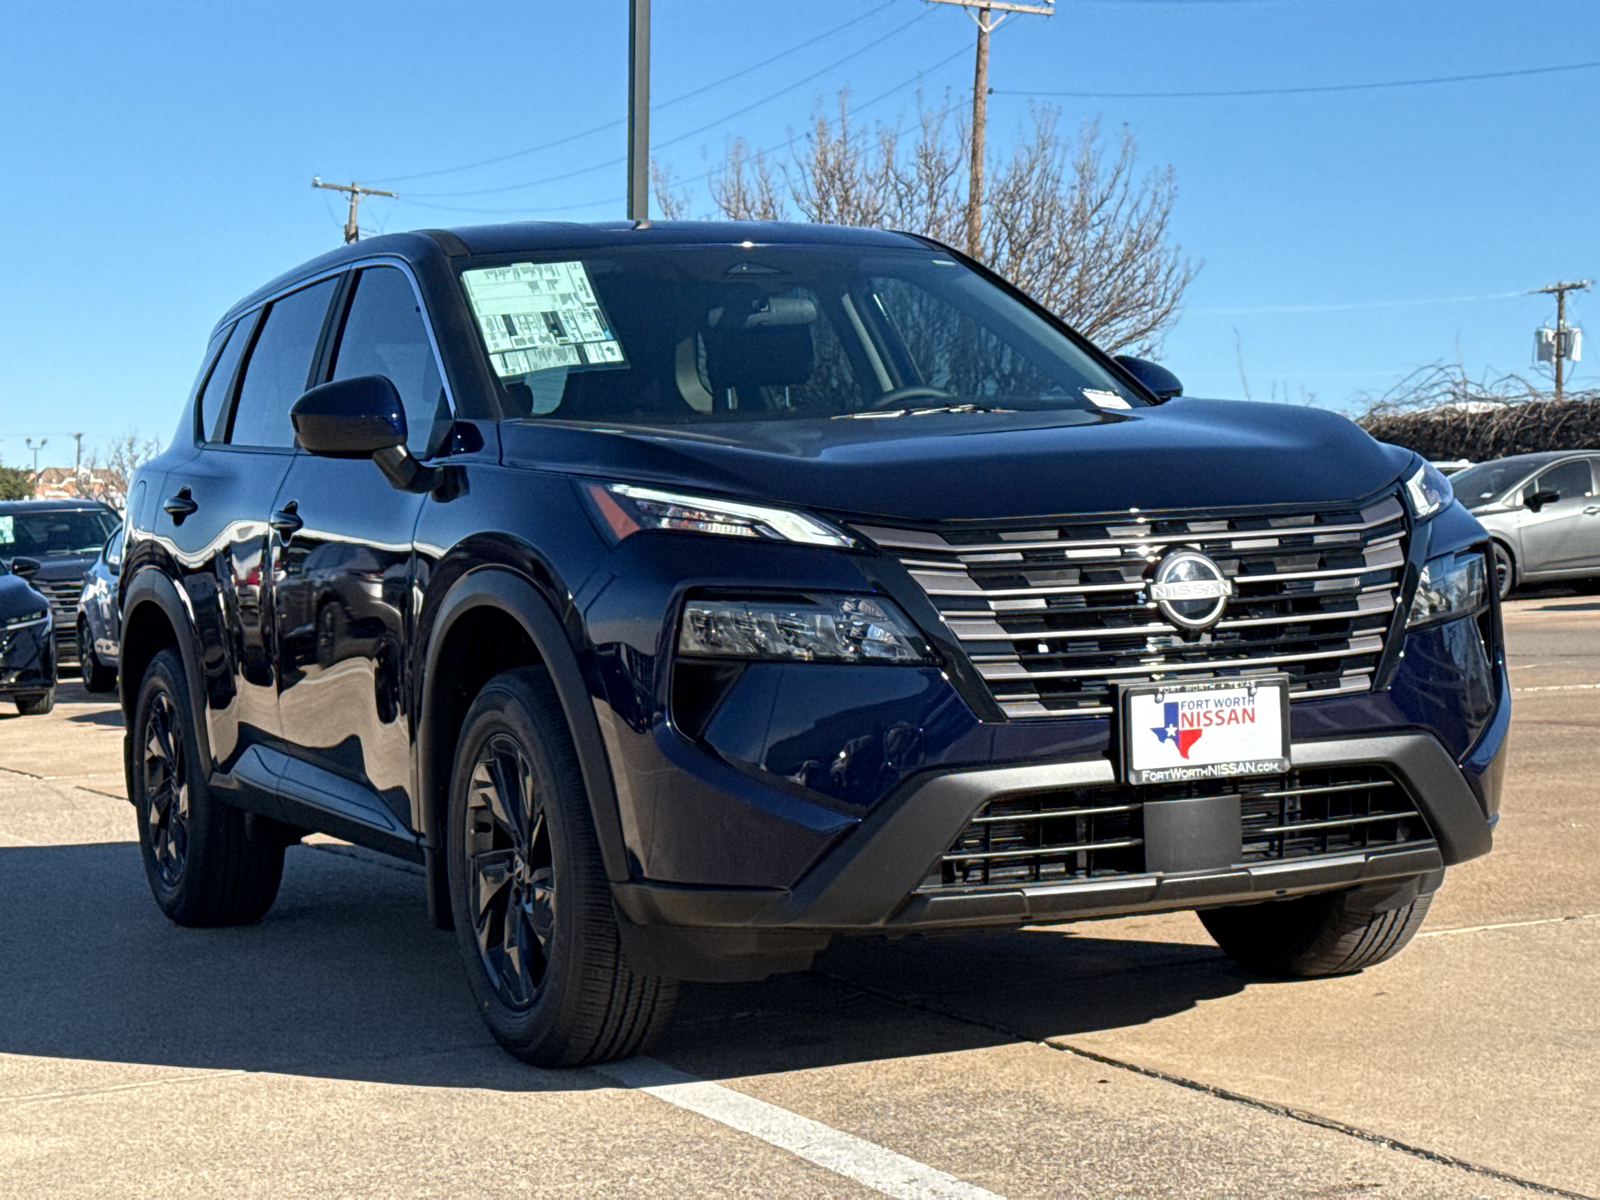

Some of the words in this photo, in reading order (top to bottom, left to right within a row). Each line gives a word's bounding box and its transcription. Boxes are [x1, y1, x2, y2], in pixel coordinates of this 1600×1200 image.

[1152, 582, 1232, 600] NISSAN
[1158, 686, 1181, 694] FORT
[1185, 683, 1216, 692] WORTH
[1229, 681, 1256, 689] TEXAS
[1180, 699, 1210, 711] FORT
[1214, 696, 1255, 709] WORTH
[1181, 707, 1256, 729] NISSAN
